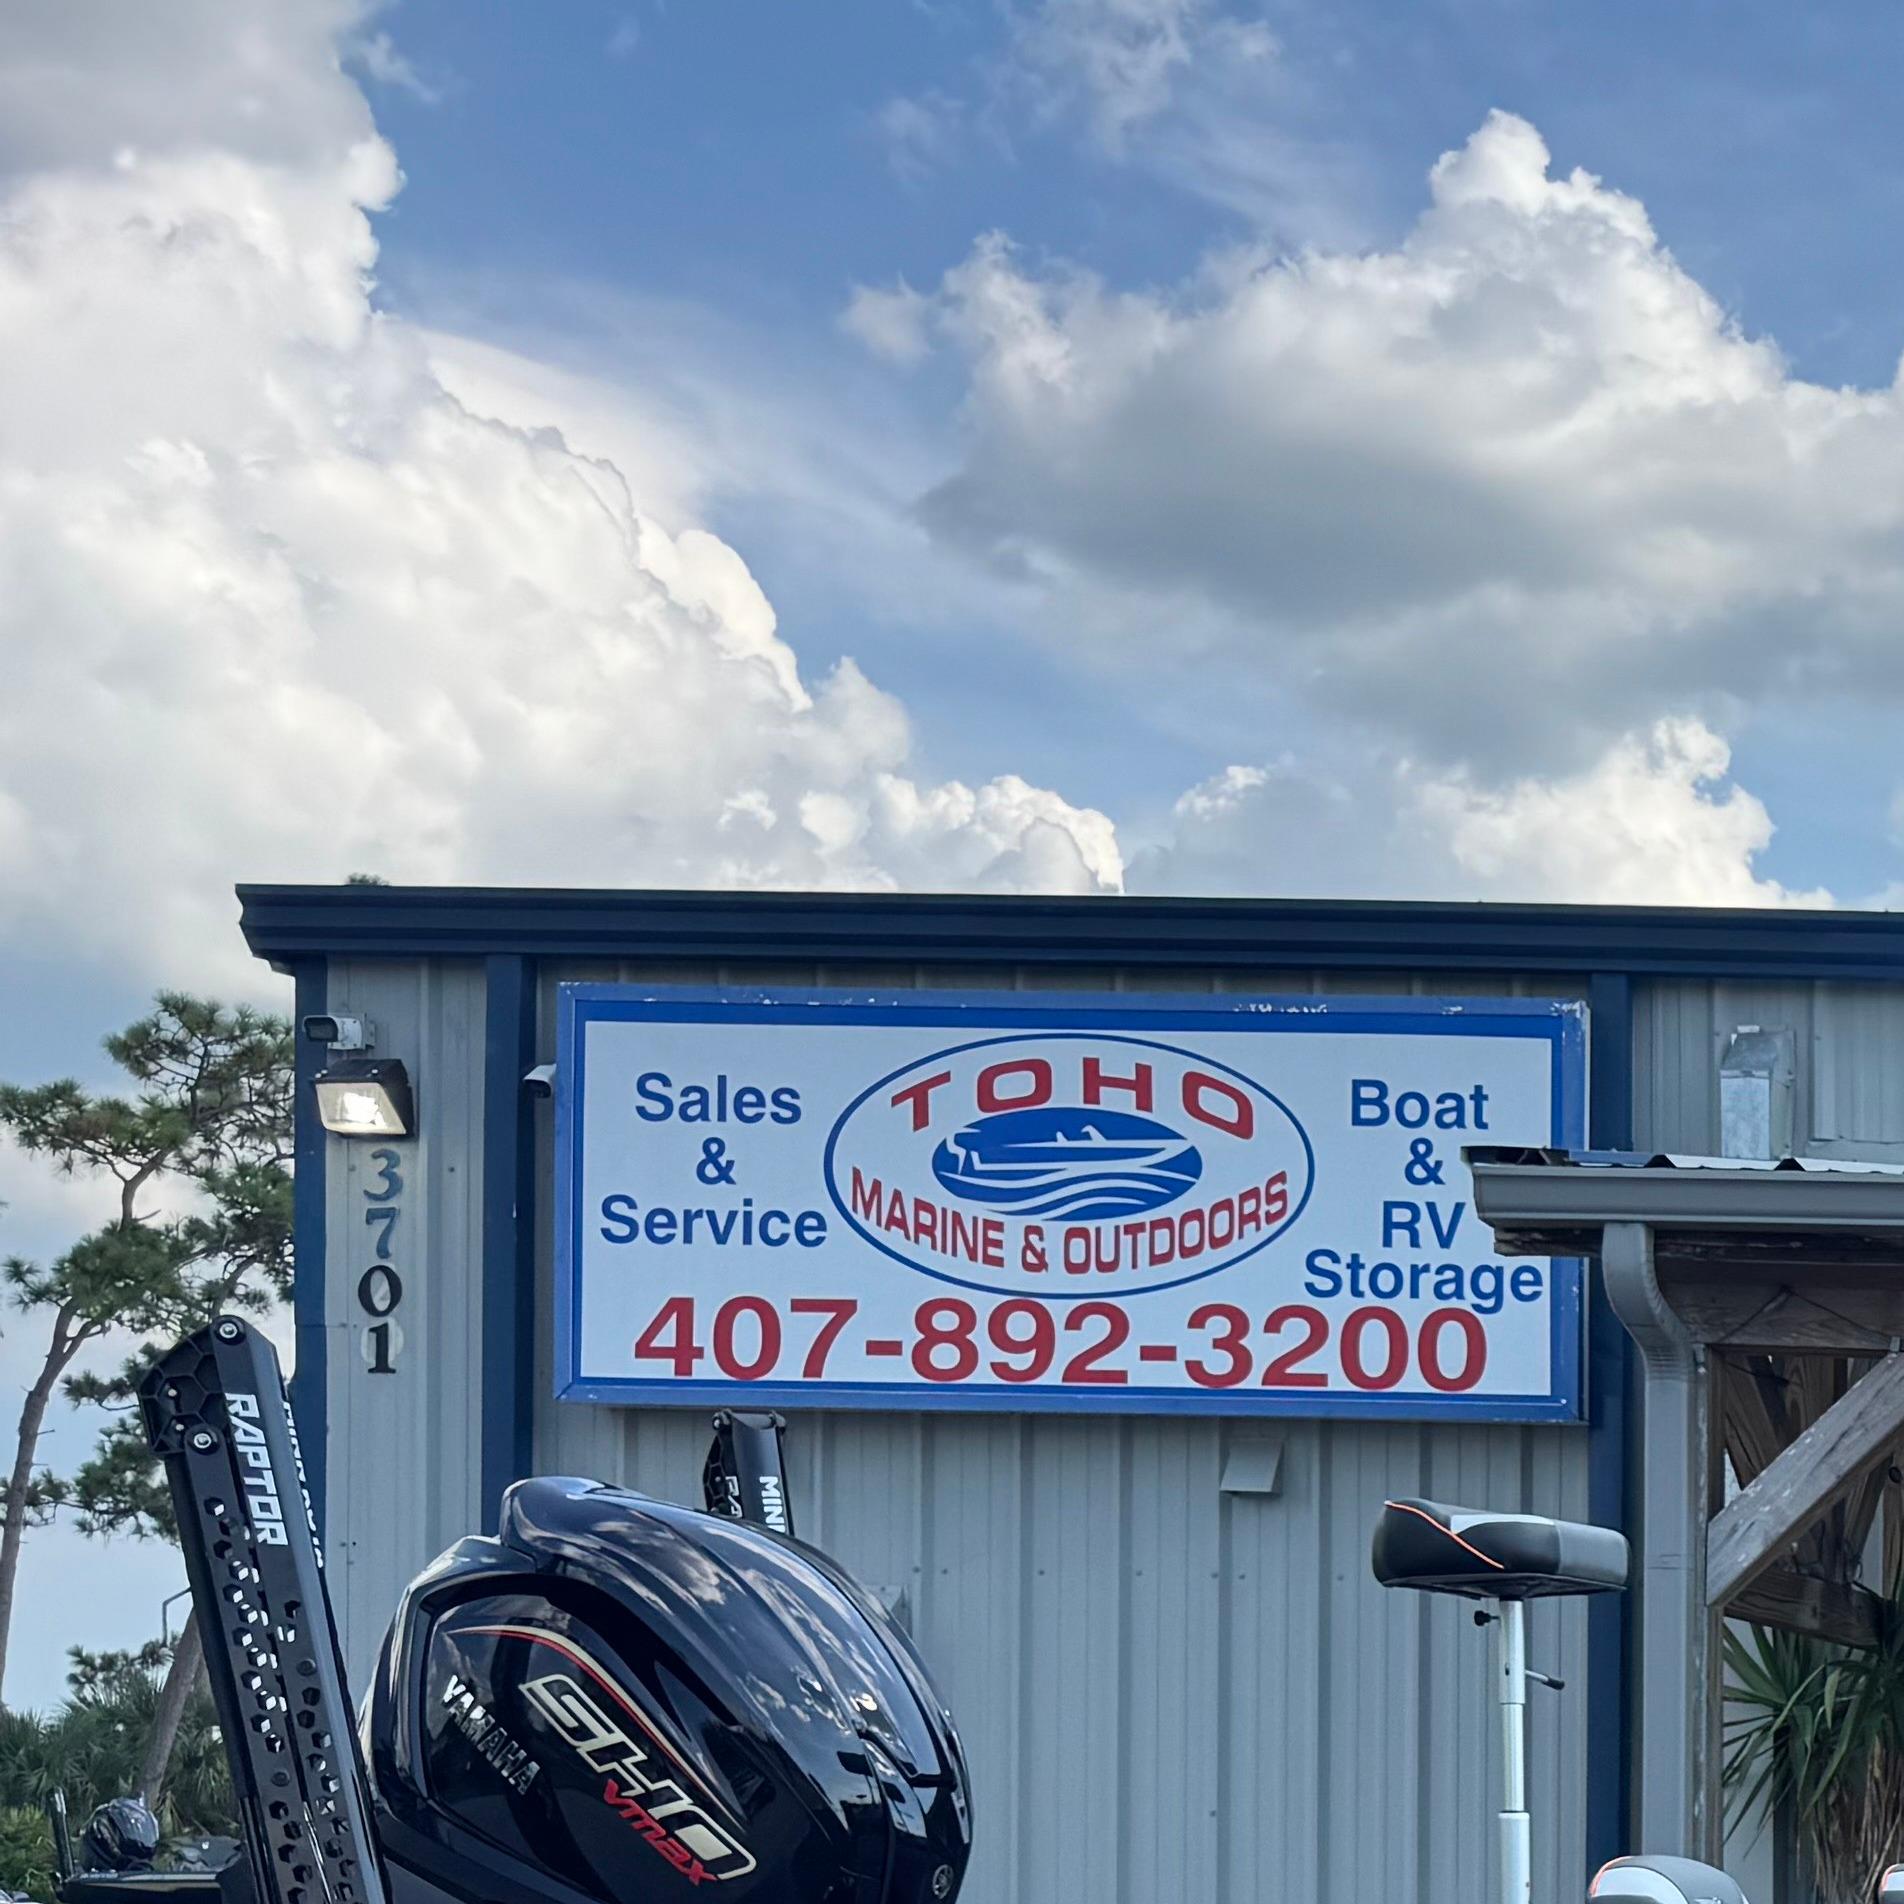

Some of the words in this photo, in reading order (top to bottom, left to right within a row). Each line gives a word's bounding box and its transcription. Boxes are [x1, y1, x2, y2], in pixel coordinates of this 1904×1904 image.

[634, 1072, 802, 1124] Sales
[890, 1057, 1255, 1141] TOHO
[1350, 1079, 1490, 1130] Boat
[696, 1136, 736, 1186] &
[1405, 1136, 1444, 1186] &
[601, 1195, 829, 1247] Service
[851, 1166, 1006, 1270] MARINE
[1021, 1220, 1050, 1273] &
[1063, 1171, 1290, 1276] OUTDOORS
[1382, 1200, 1466, 1249] RV
[358, 1149, 403, 1375] 3701
[1303, 1250, 1545, 1314] Storage
[634, 1296, 1489, 1393] 407-892-3200
[224, 1392, 288, 1546] RAPTOR
[442, 1674, 541, 1796] YAMAHA
